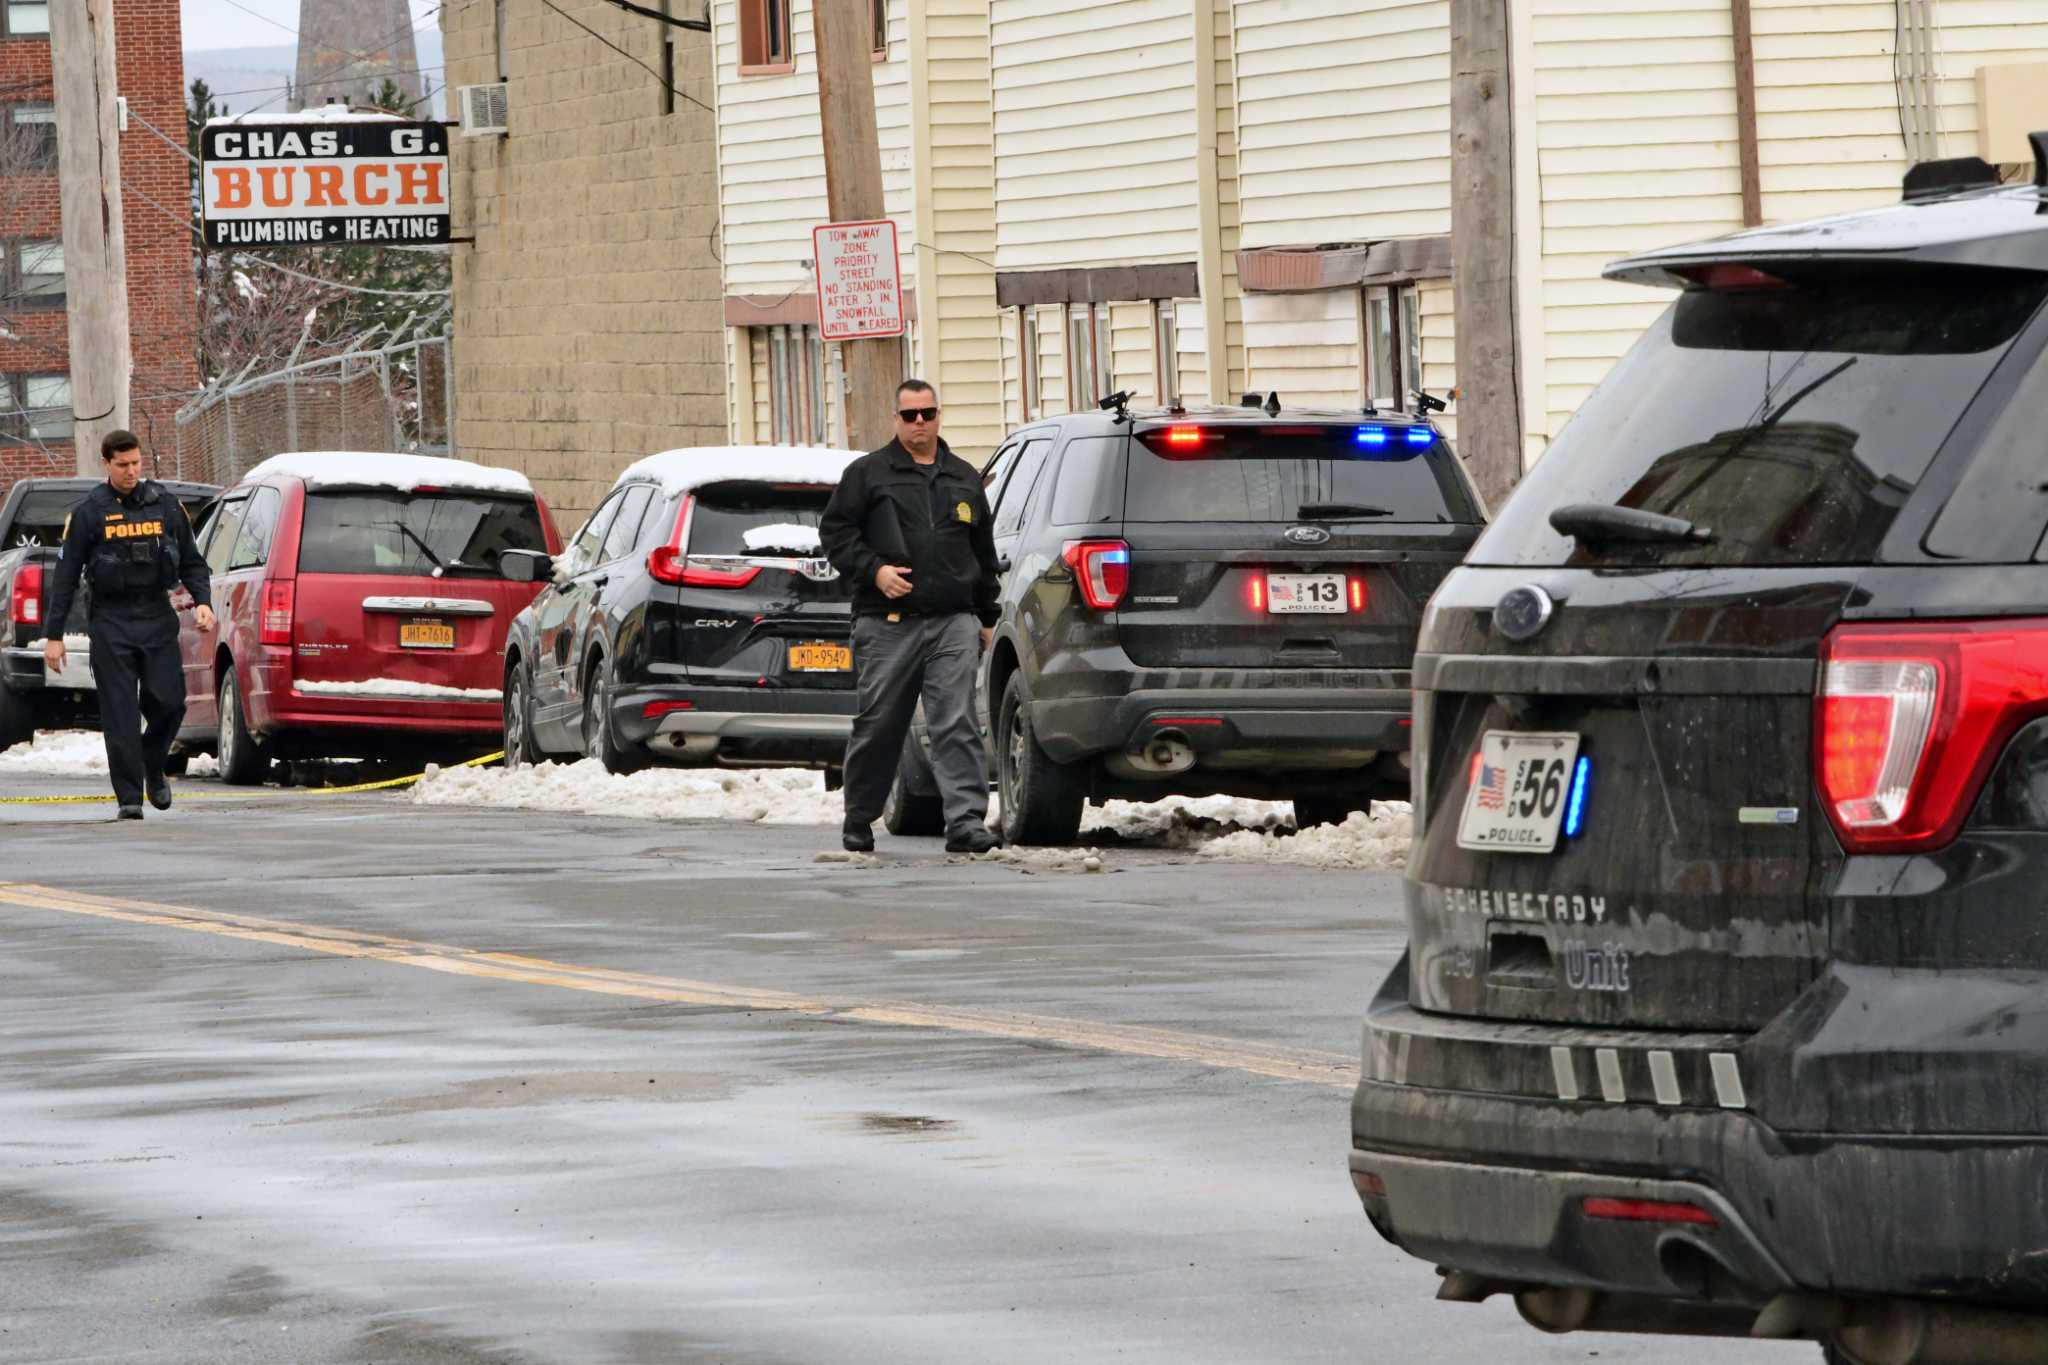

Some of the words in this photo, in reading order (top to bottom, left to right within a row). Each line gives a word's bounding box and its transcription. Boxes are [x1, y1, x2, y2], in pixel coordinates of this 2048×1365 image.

[214, 130, 354, 158] CHAS.
[390, 128, 440, 155] G.
[211, 162, 445, 209] BURCH
[216, 219, 324, 243] PLUMBING
[344, 217, 439, 240] HEATING
[857, 226, 880, 239] AWAY
[843, 242, 869, 254] ZONE
[834, 254, 879, 267] PRIORITY
[840, 267, 875, 280] STREET
[825, 282, 839, 295] NO
[847, 279, 893, 293] STANDING
[827, 295, 858, 307] AFTER
[866, 293, 873, 304] 3
[835, 306, 885, 320] SNOWFALL
[825, 322, 849, 334] UNTIL
[105, 521, 163, 540] POLICE
[1307, 582, 1339, 602] 13
[695, 619, 738, 629] CR-V
[1520, 758, 1565, 819] 56
[1488, 828, 1535, 842] POLICE
[1445, 887, 1606, 922] SCHENECTADY
[1564, 939, 1630, 992] Unit
